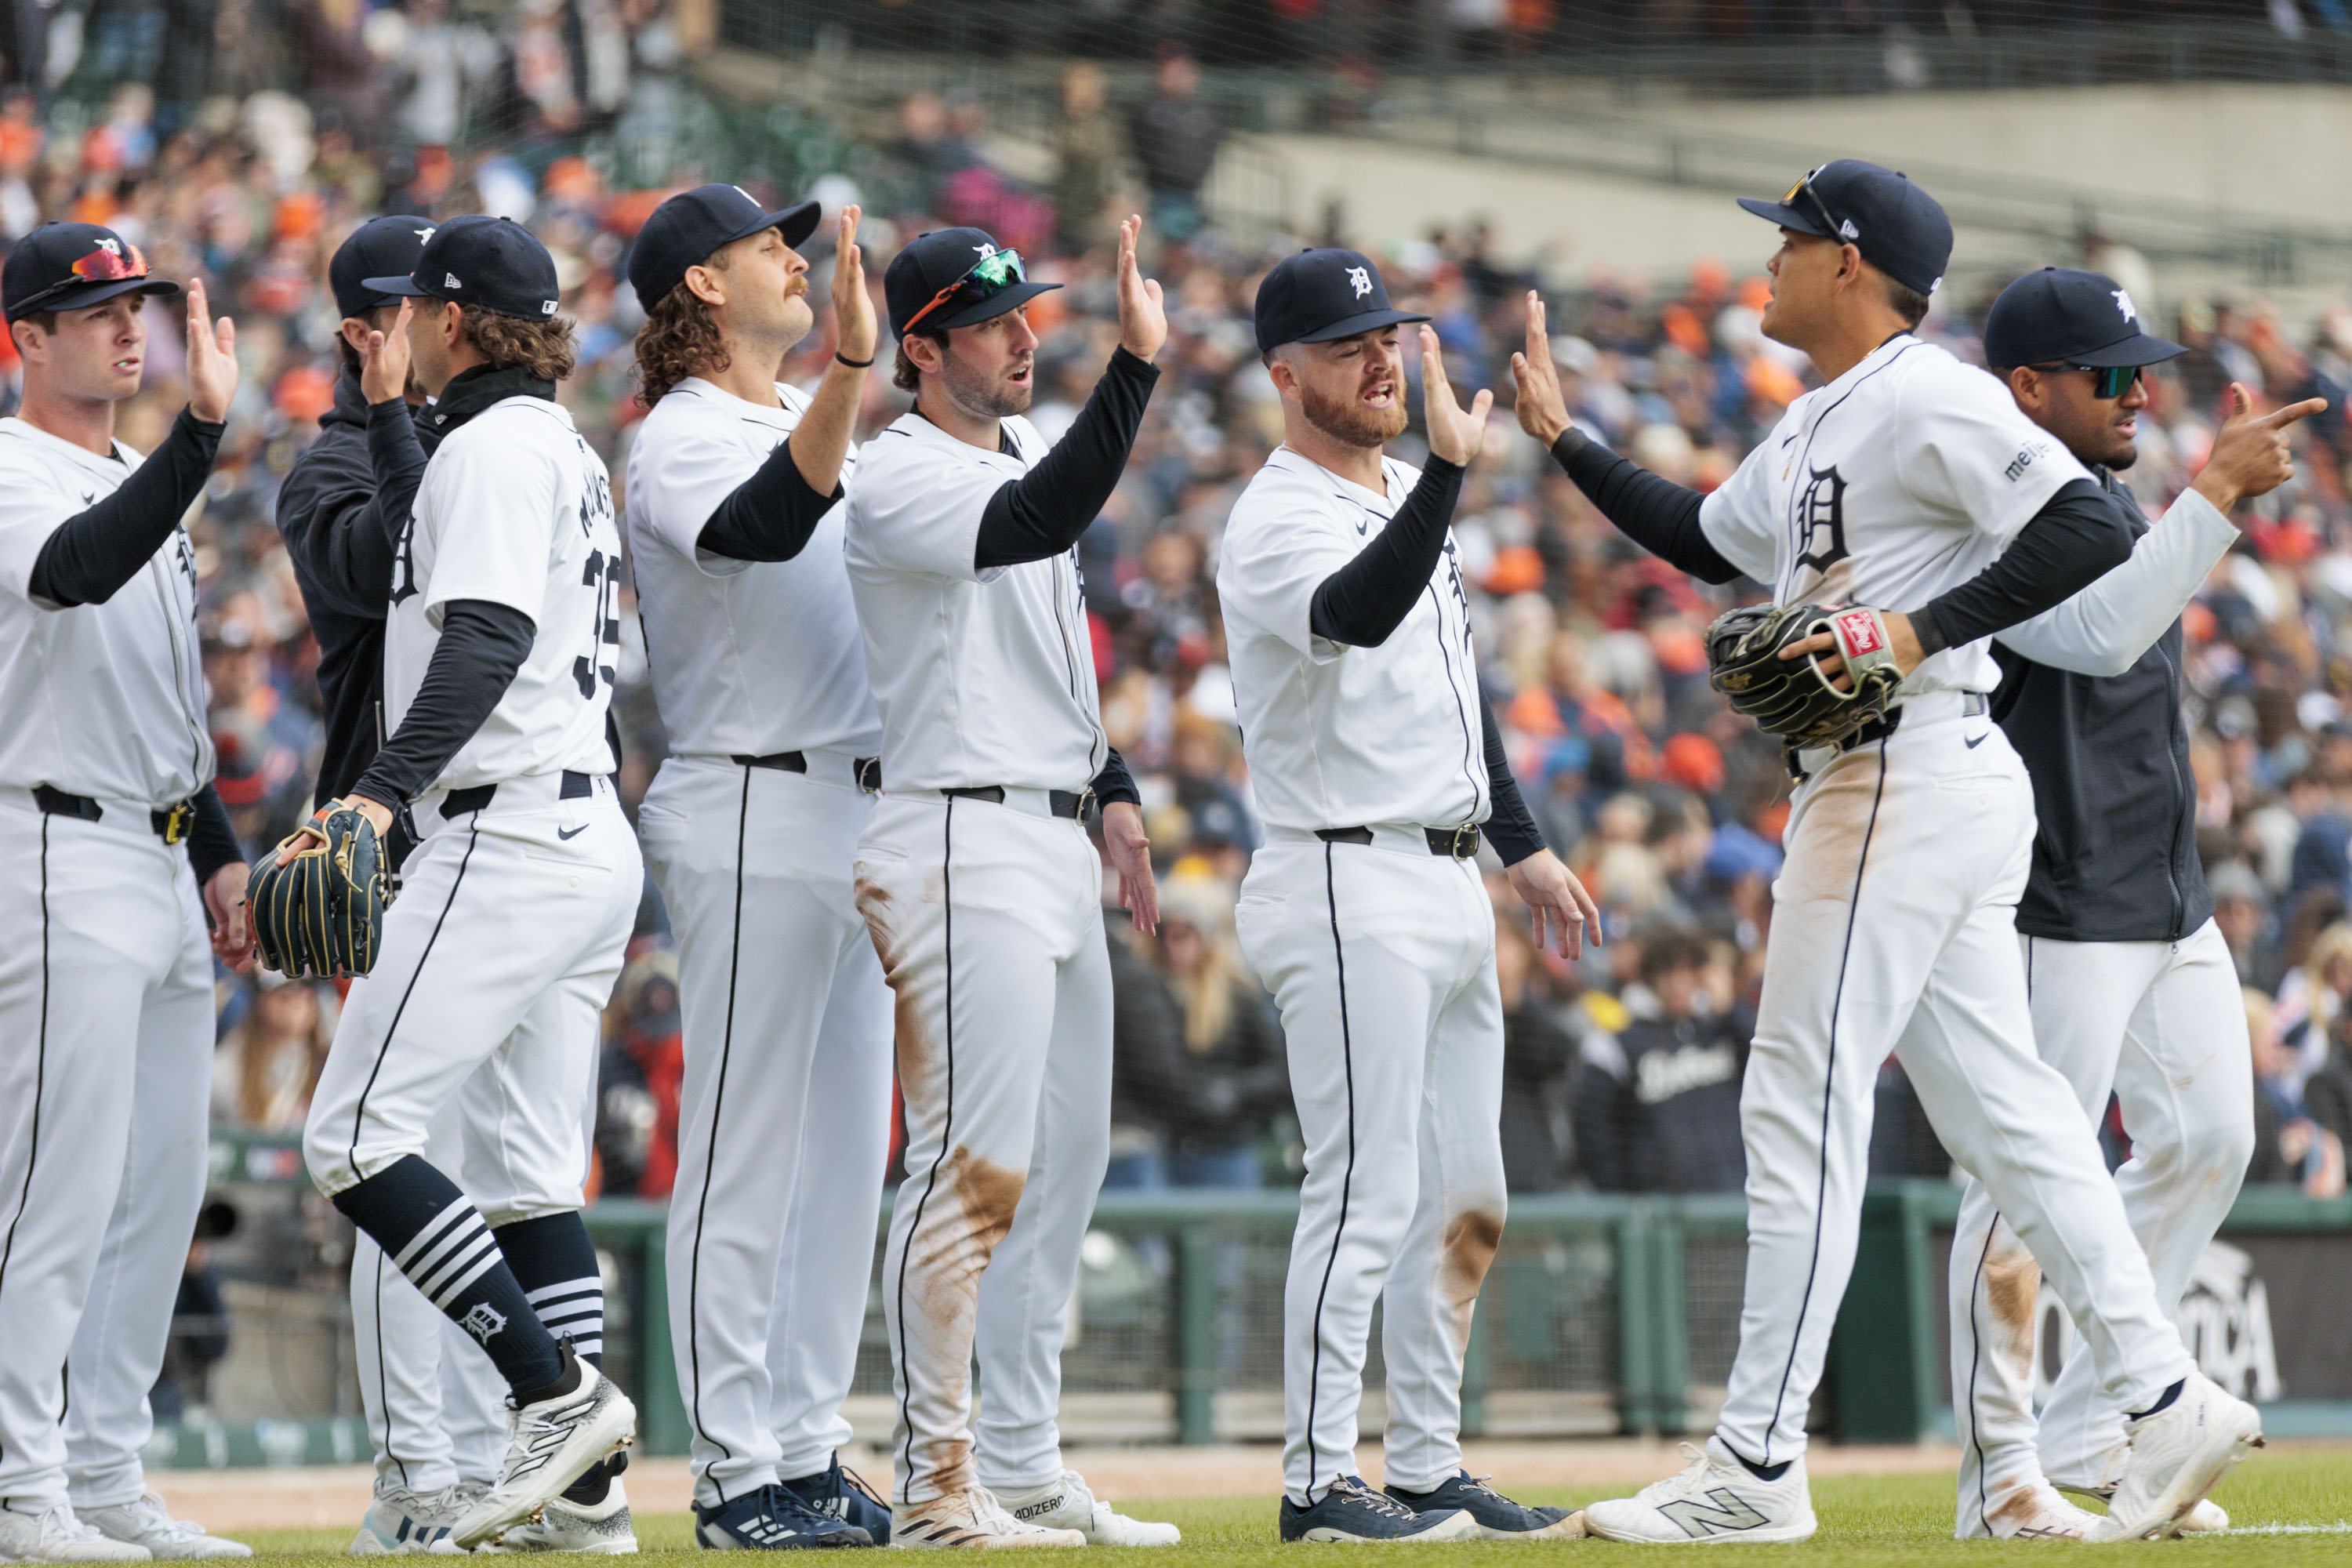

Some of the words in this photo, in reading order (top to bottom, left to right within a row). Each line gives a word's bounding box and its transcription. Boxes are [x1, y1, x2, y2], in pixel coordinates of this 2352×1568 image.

[1345, 266, 1374, 301] D
[1793, 458, 1851, 578] D
[457, 1301, 508, 1347] D
[1014, 1494, 1065, 1520] ADIZERO
